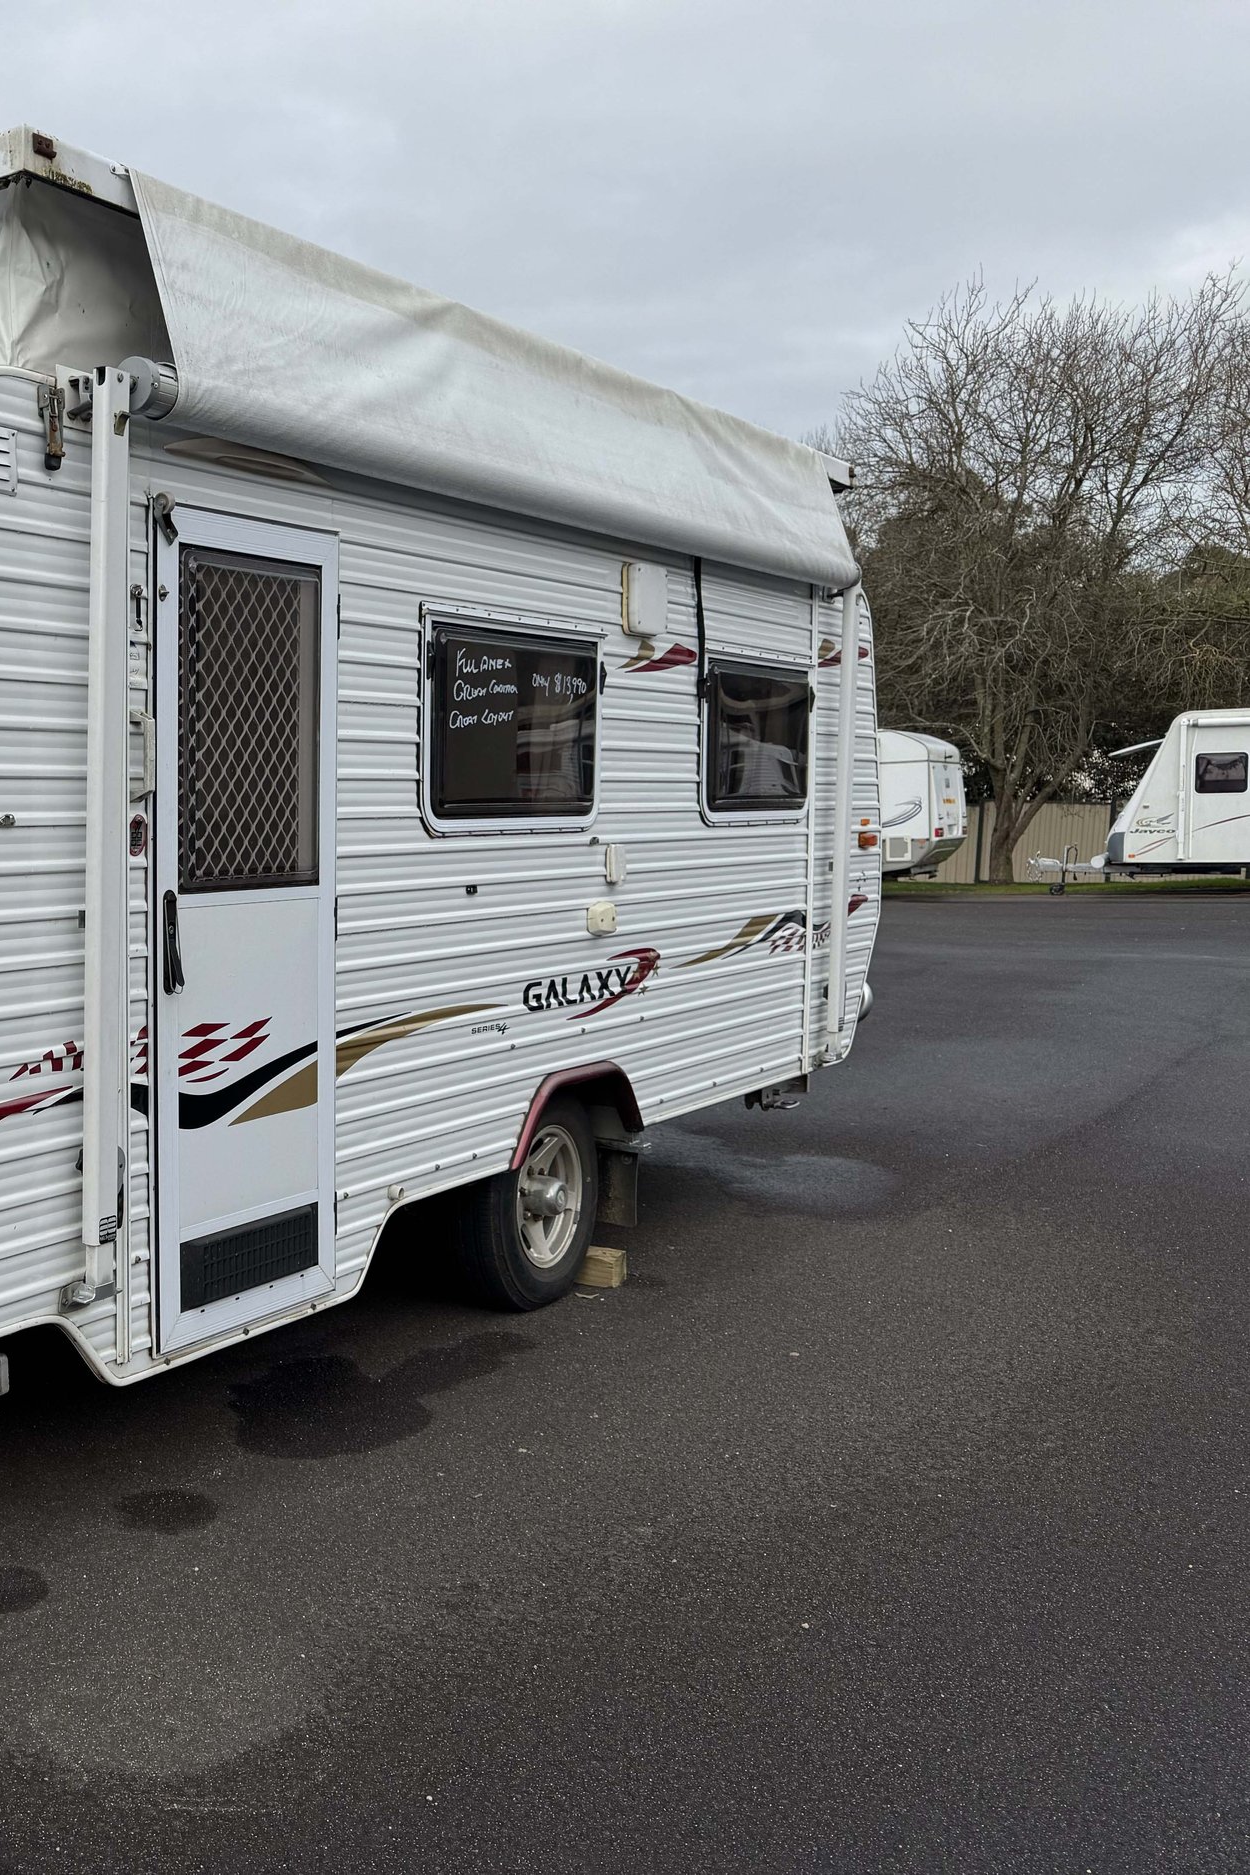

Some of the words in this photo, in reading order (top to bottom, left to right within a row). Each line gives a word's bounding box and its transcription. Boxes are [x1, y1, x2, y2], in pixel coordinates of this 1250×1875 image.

[480, 656, 512, 673] ANEX
[554, 672, 587, 705] $13,990
[522, 965, 632, 1012] GALAXY
